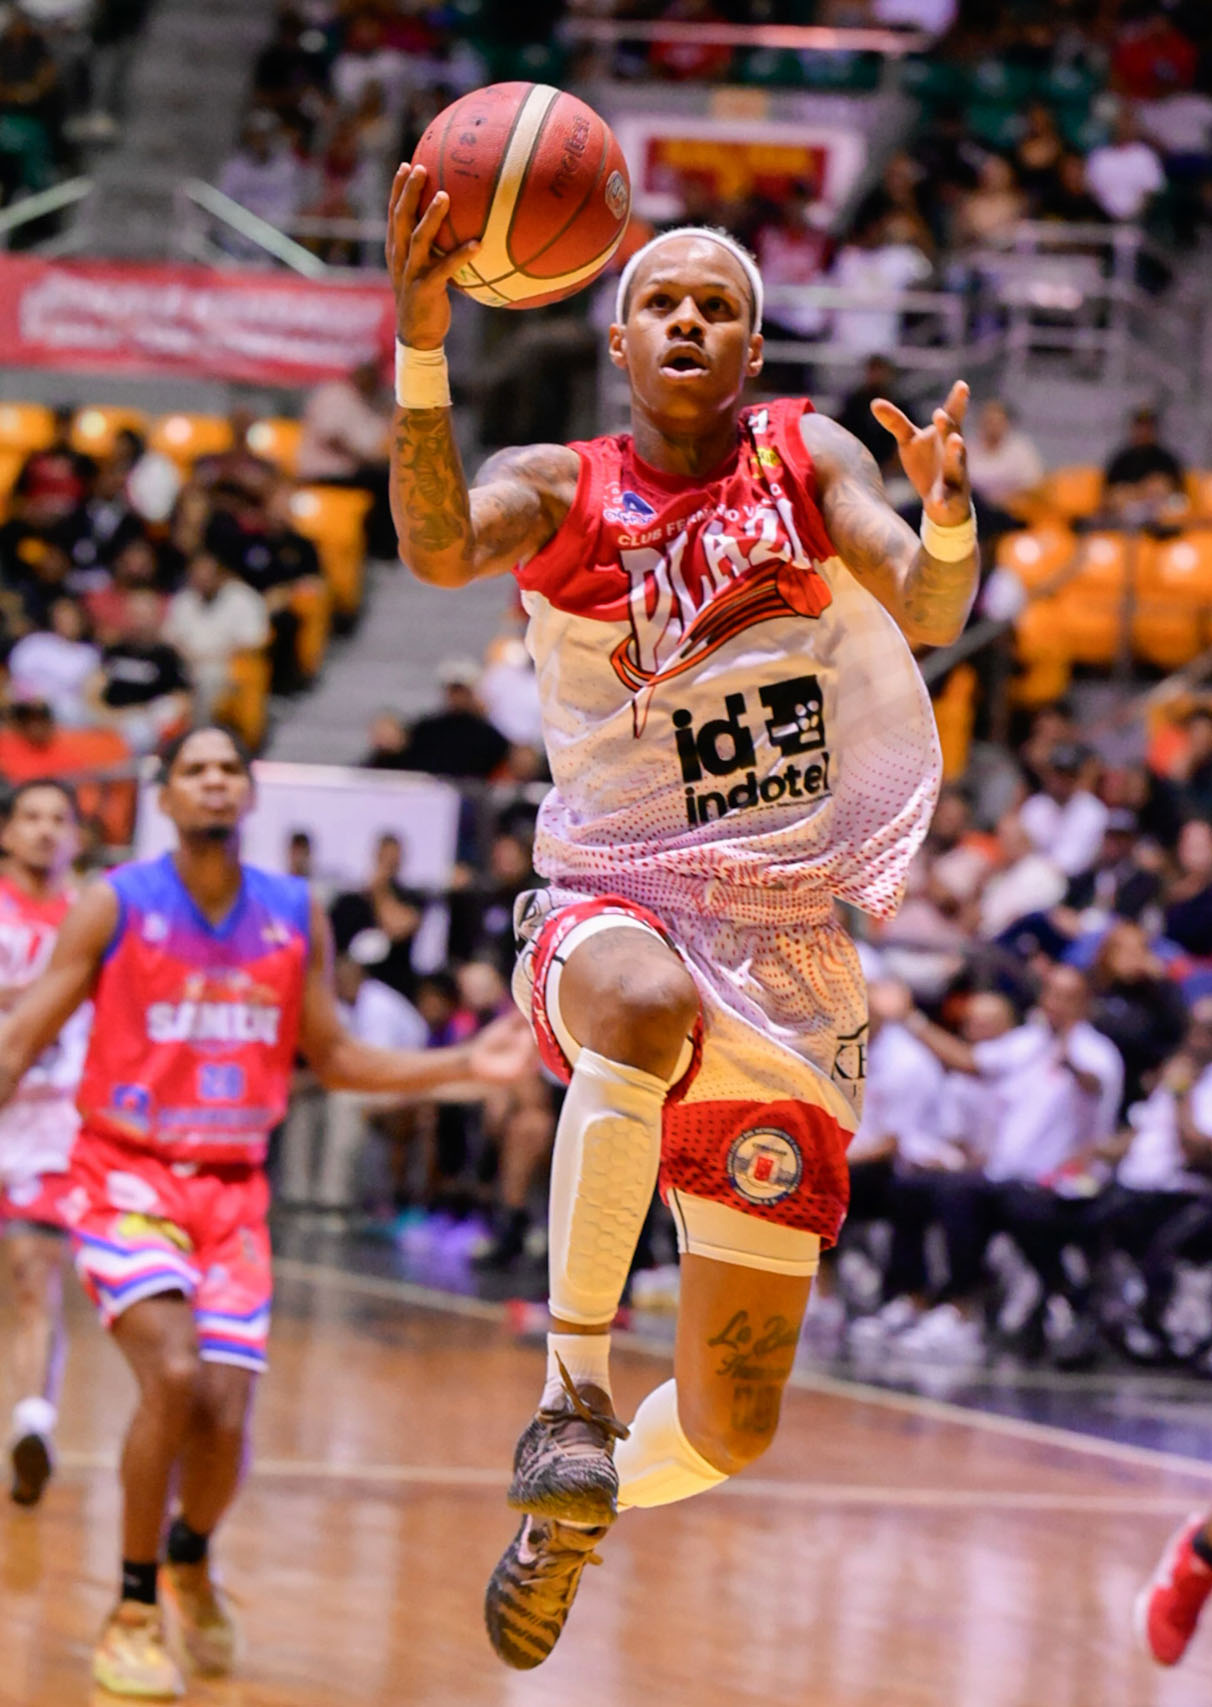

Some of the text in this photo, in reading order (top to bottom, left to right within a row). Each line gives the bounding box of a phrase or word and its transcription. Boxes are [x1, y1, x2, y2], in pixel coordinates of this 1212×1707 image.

[617, 528, 662, 546] CLUB
[672, 692, 757, 783] id
[685, 752, 830, 825] indotel
